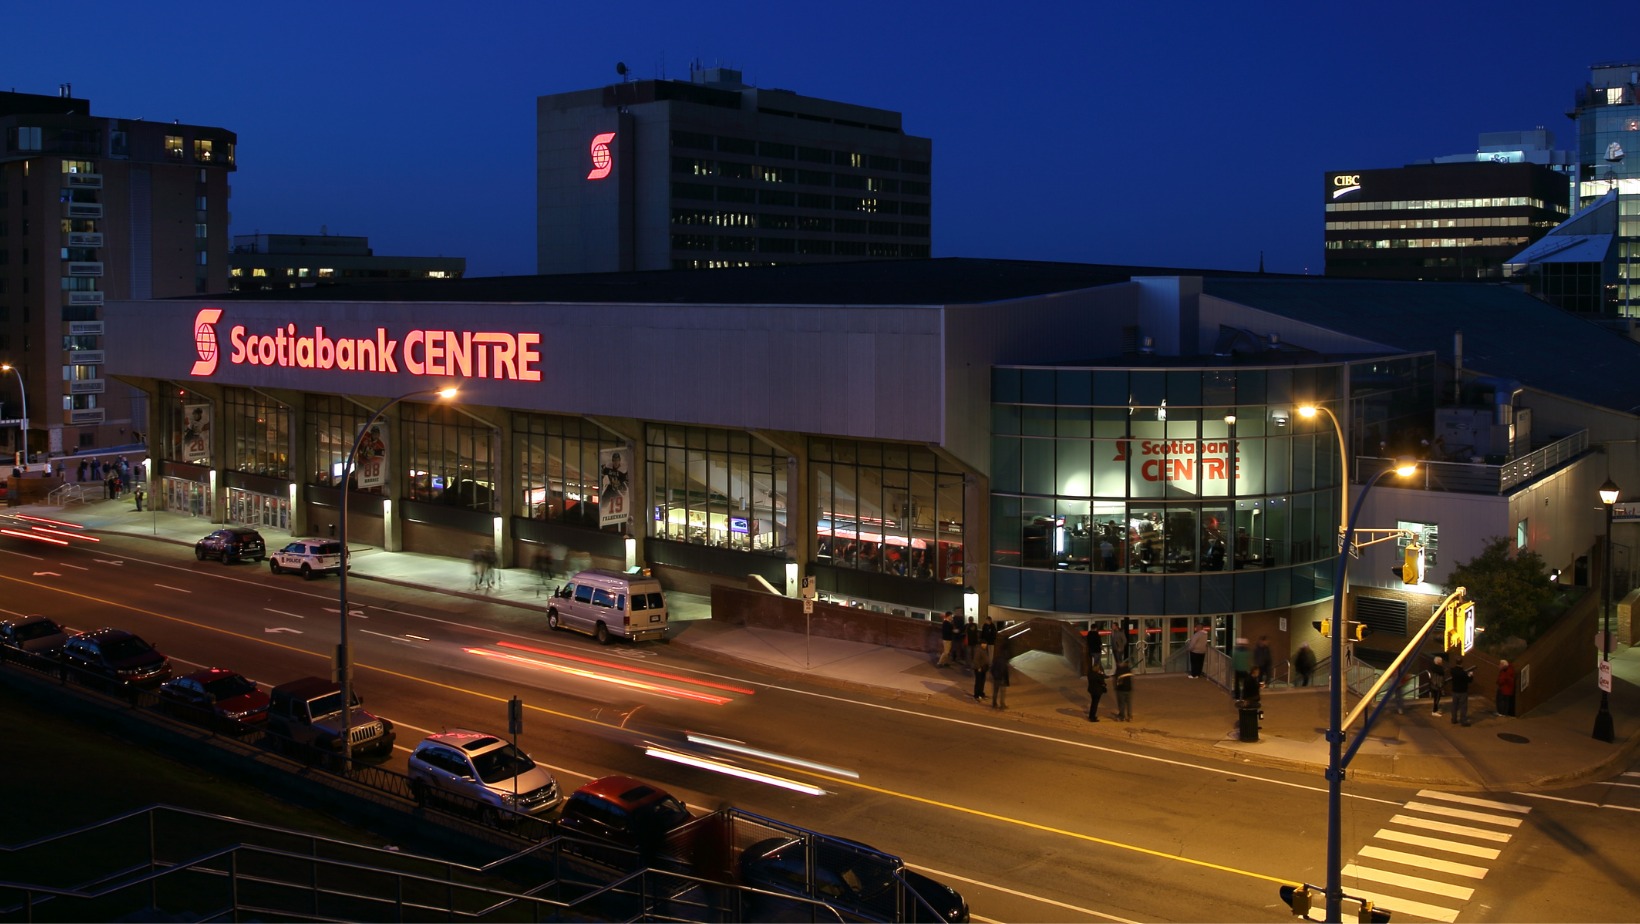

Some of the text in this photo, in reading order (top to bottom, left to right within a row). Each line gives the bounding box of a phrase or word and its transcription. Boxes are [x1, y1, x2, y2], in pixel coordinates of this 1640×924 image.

[1333, 174, 1361, 187] CIBC
[230, 322, 398, 374] Scotiabank
[402, 329, 542, 381] CENTRE
[190, 439, 205, 452] 28
[609, 496, 623, 514] 19
